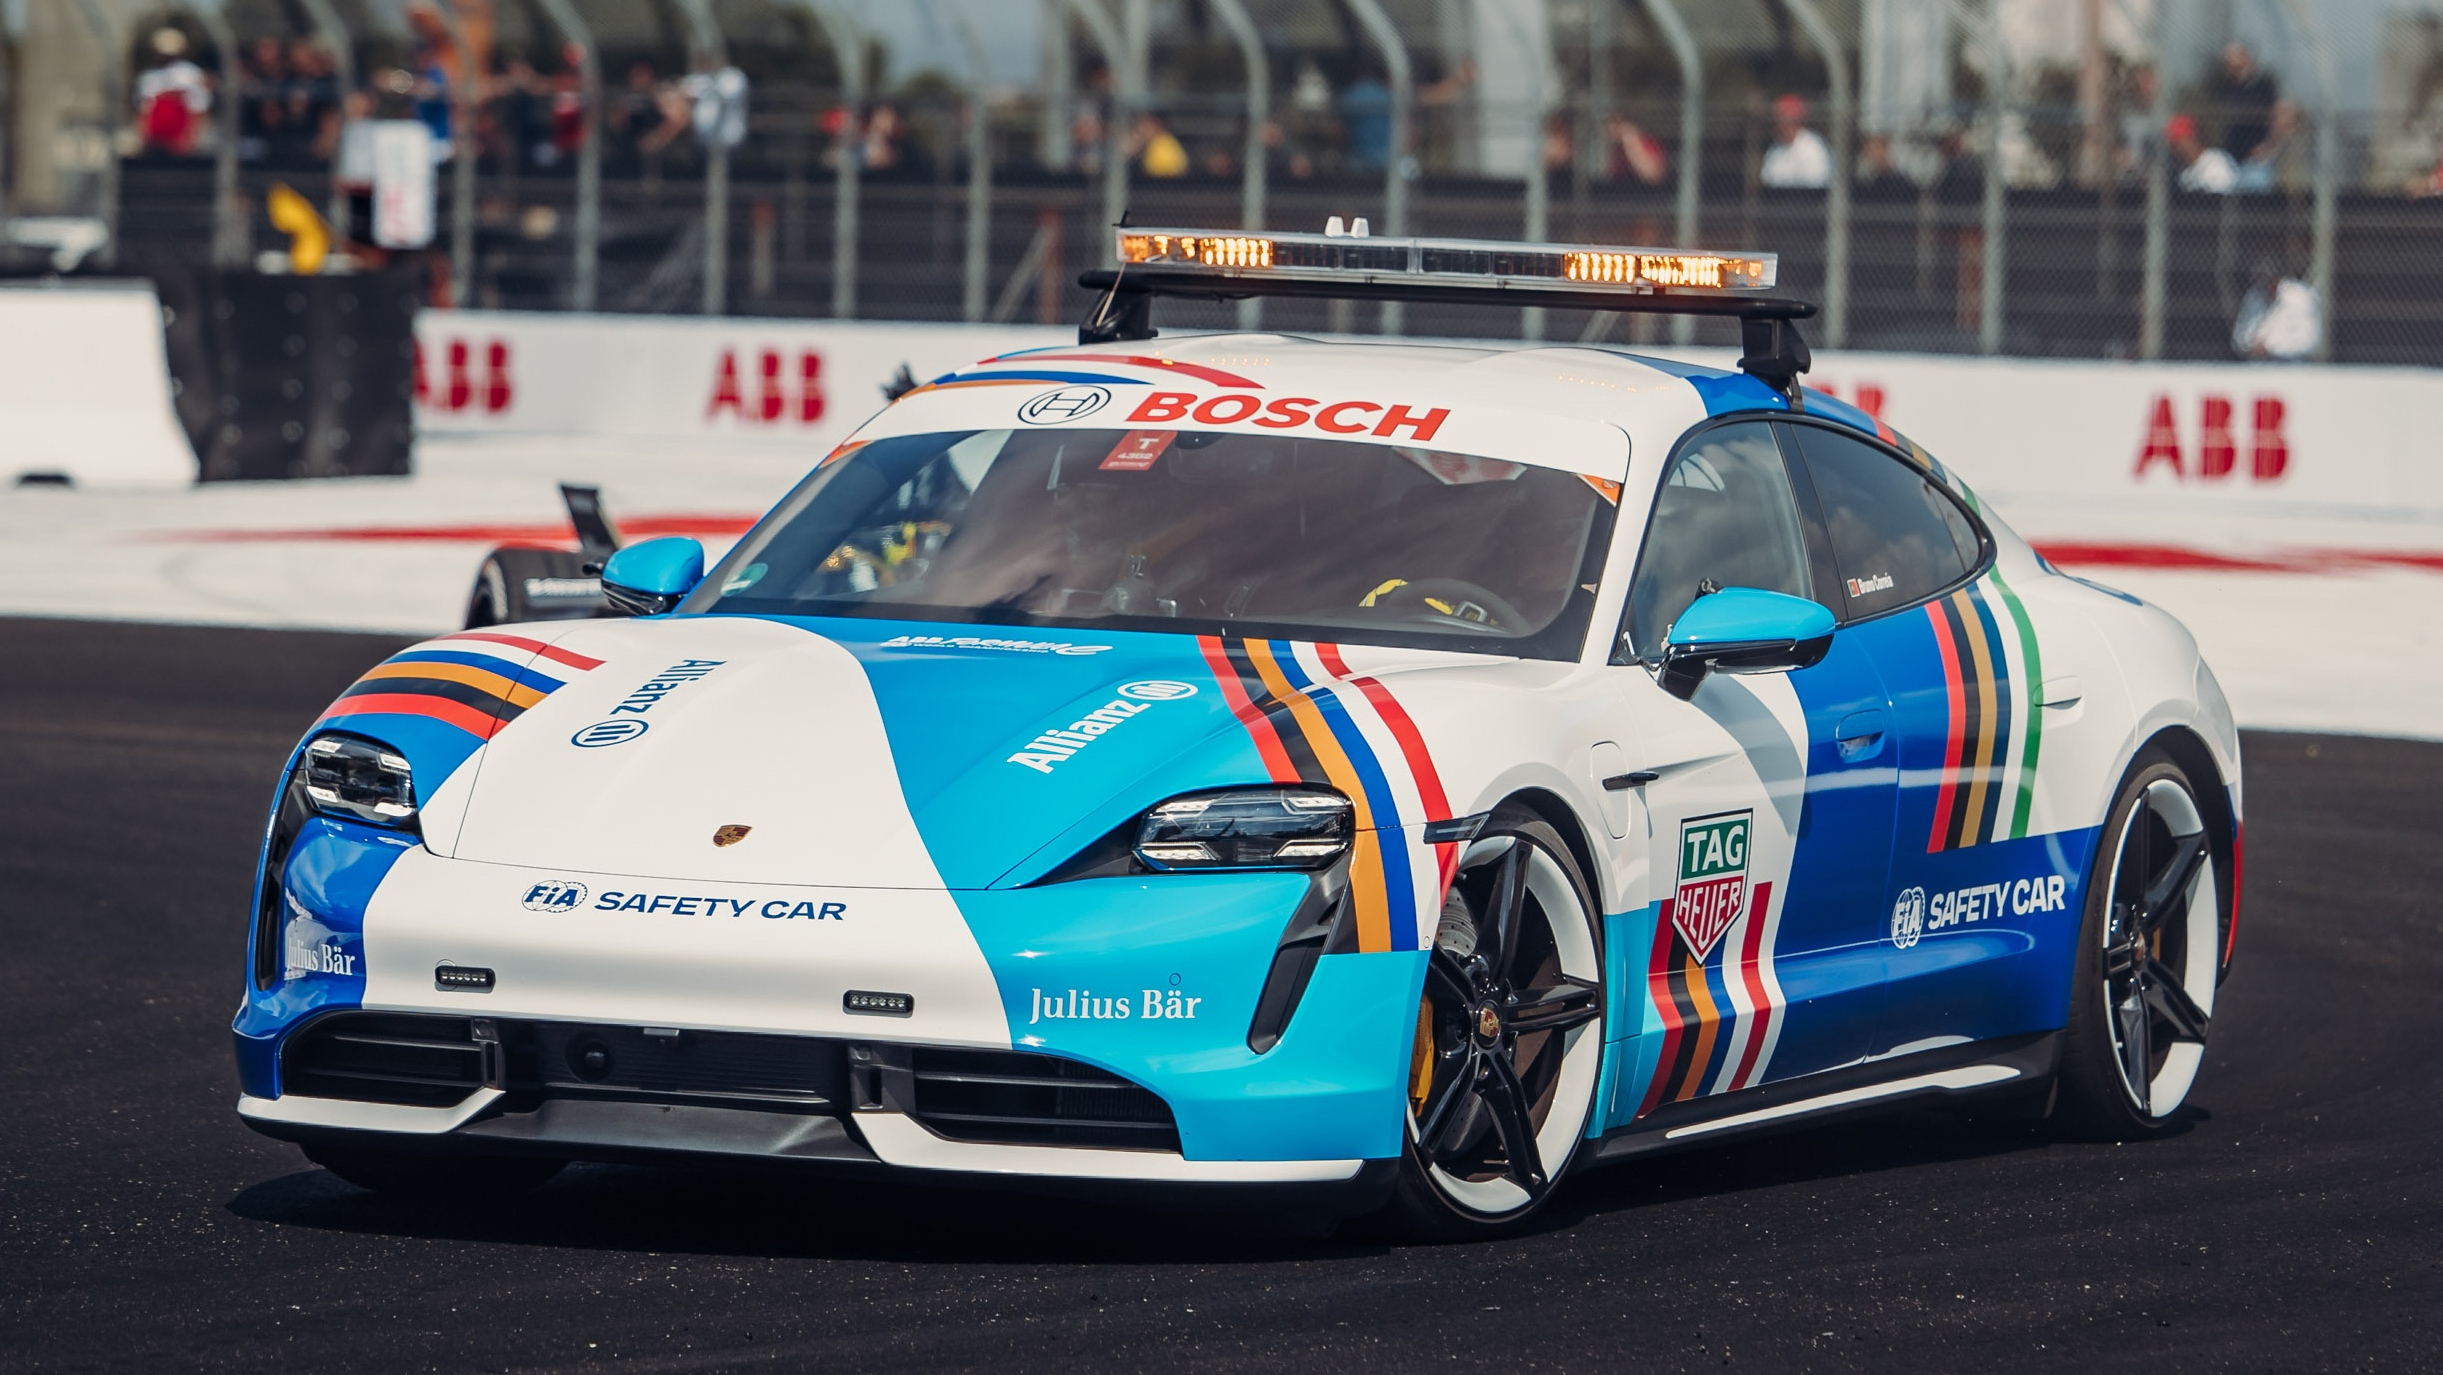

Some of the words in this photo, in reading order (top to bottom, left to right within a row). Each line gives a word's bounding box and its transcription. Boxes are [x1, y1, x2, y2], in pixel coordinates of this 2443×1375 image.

[705, 348, 826, 423] ABB
[1125, 391, 1452, 442] BOSCH
[2133, 397, 2290, 479] ABB
[1139, 437, 1160, 450] T
[609, 659, 728, 715] Allianz
[1006, 699, 1152, 774] Allianz
[1687, 825, 1744, 873] TAG
[594, 891, 757, 918] SAFETY
[760, 900, 848, 921] CAR
[1678, 881, 1742, 951] HEUER
[1928, 881, 2011, 930] SAFETY
[2012, 875, 2066, 916] CAR
[321, 943, 355, 976] Bär
[1029, 988, 1131, 1024] Julius
[1140, 989, 1202, 1020] Bär
